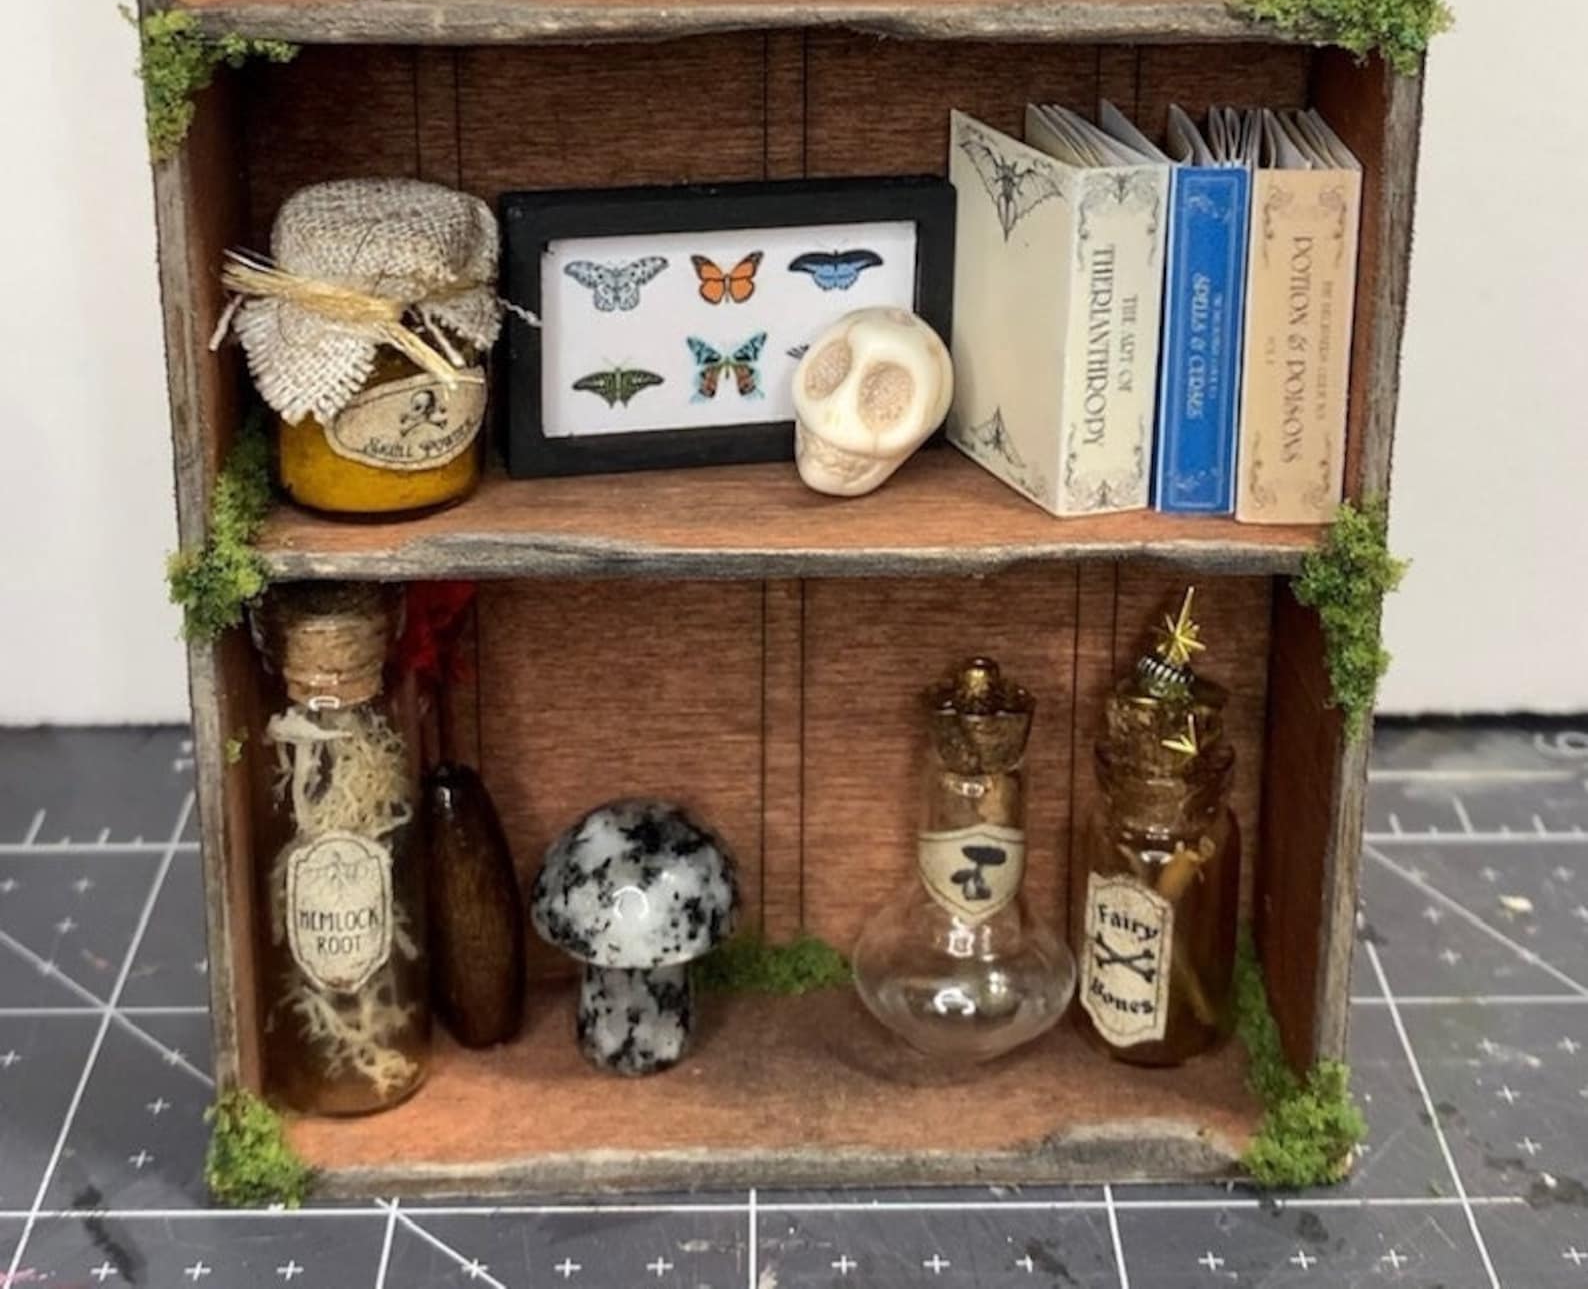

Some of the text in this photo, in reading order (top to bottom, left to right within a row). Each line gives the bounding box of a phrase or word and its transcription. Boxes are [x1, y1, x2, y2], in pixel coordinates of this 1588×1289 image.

[1288, 236, 1314, 326] POTION
[1083, 244, 1115, 446] THERIANTHROPY
[1281, 360, 1306, 464] POISONS
[300, 906, 380, 931] HEMLOCK
[1098, 904, 1159, 942] Fairy
[317, 935, 361, 954] ROOT
[1091, 977, 1155, 1014] Bones
